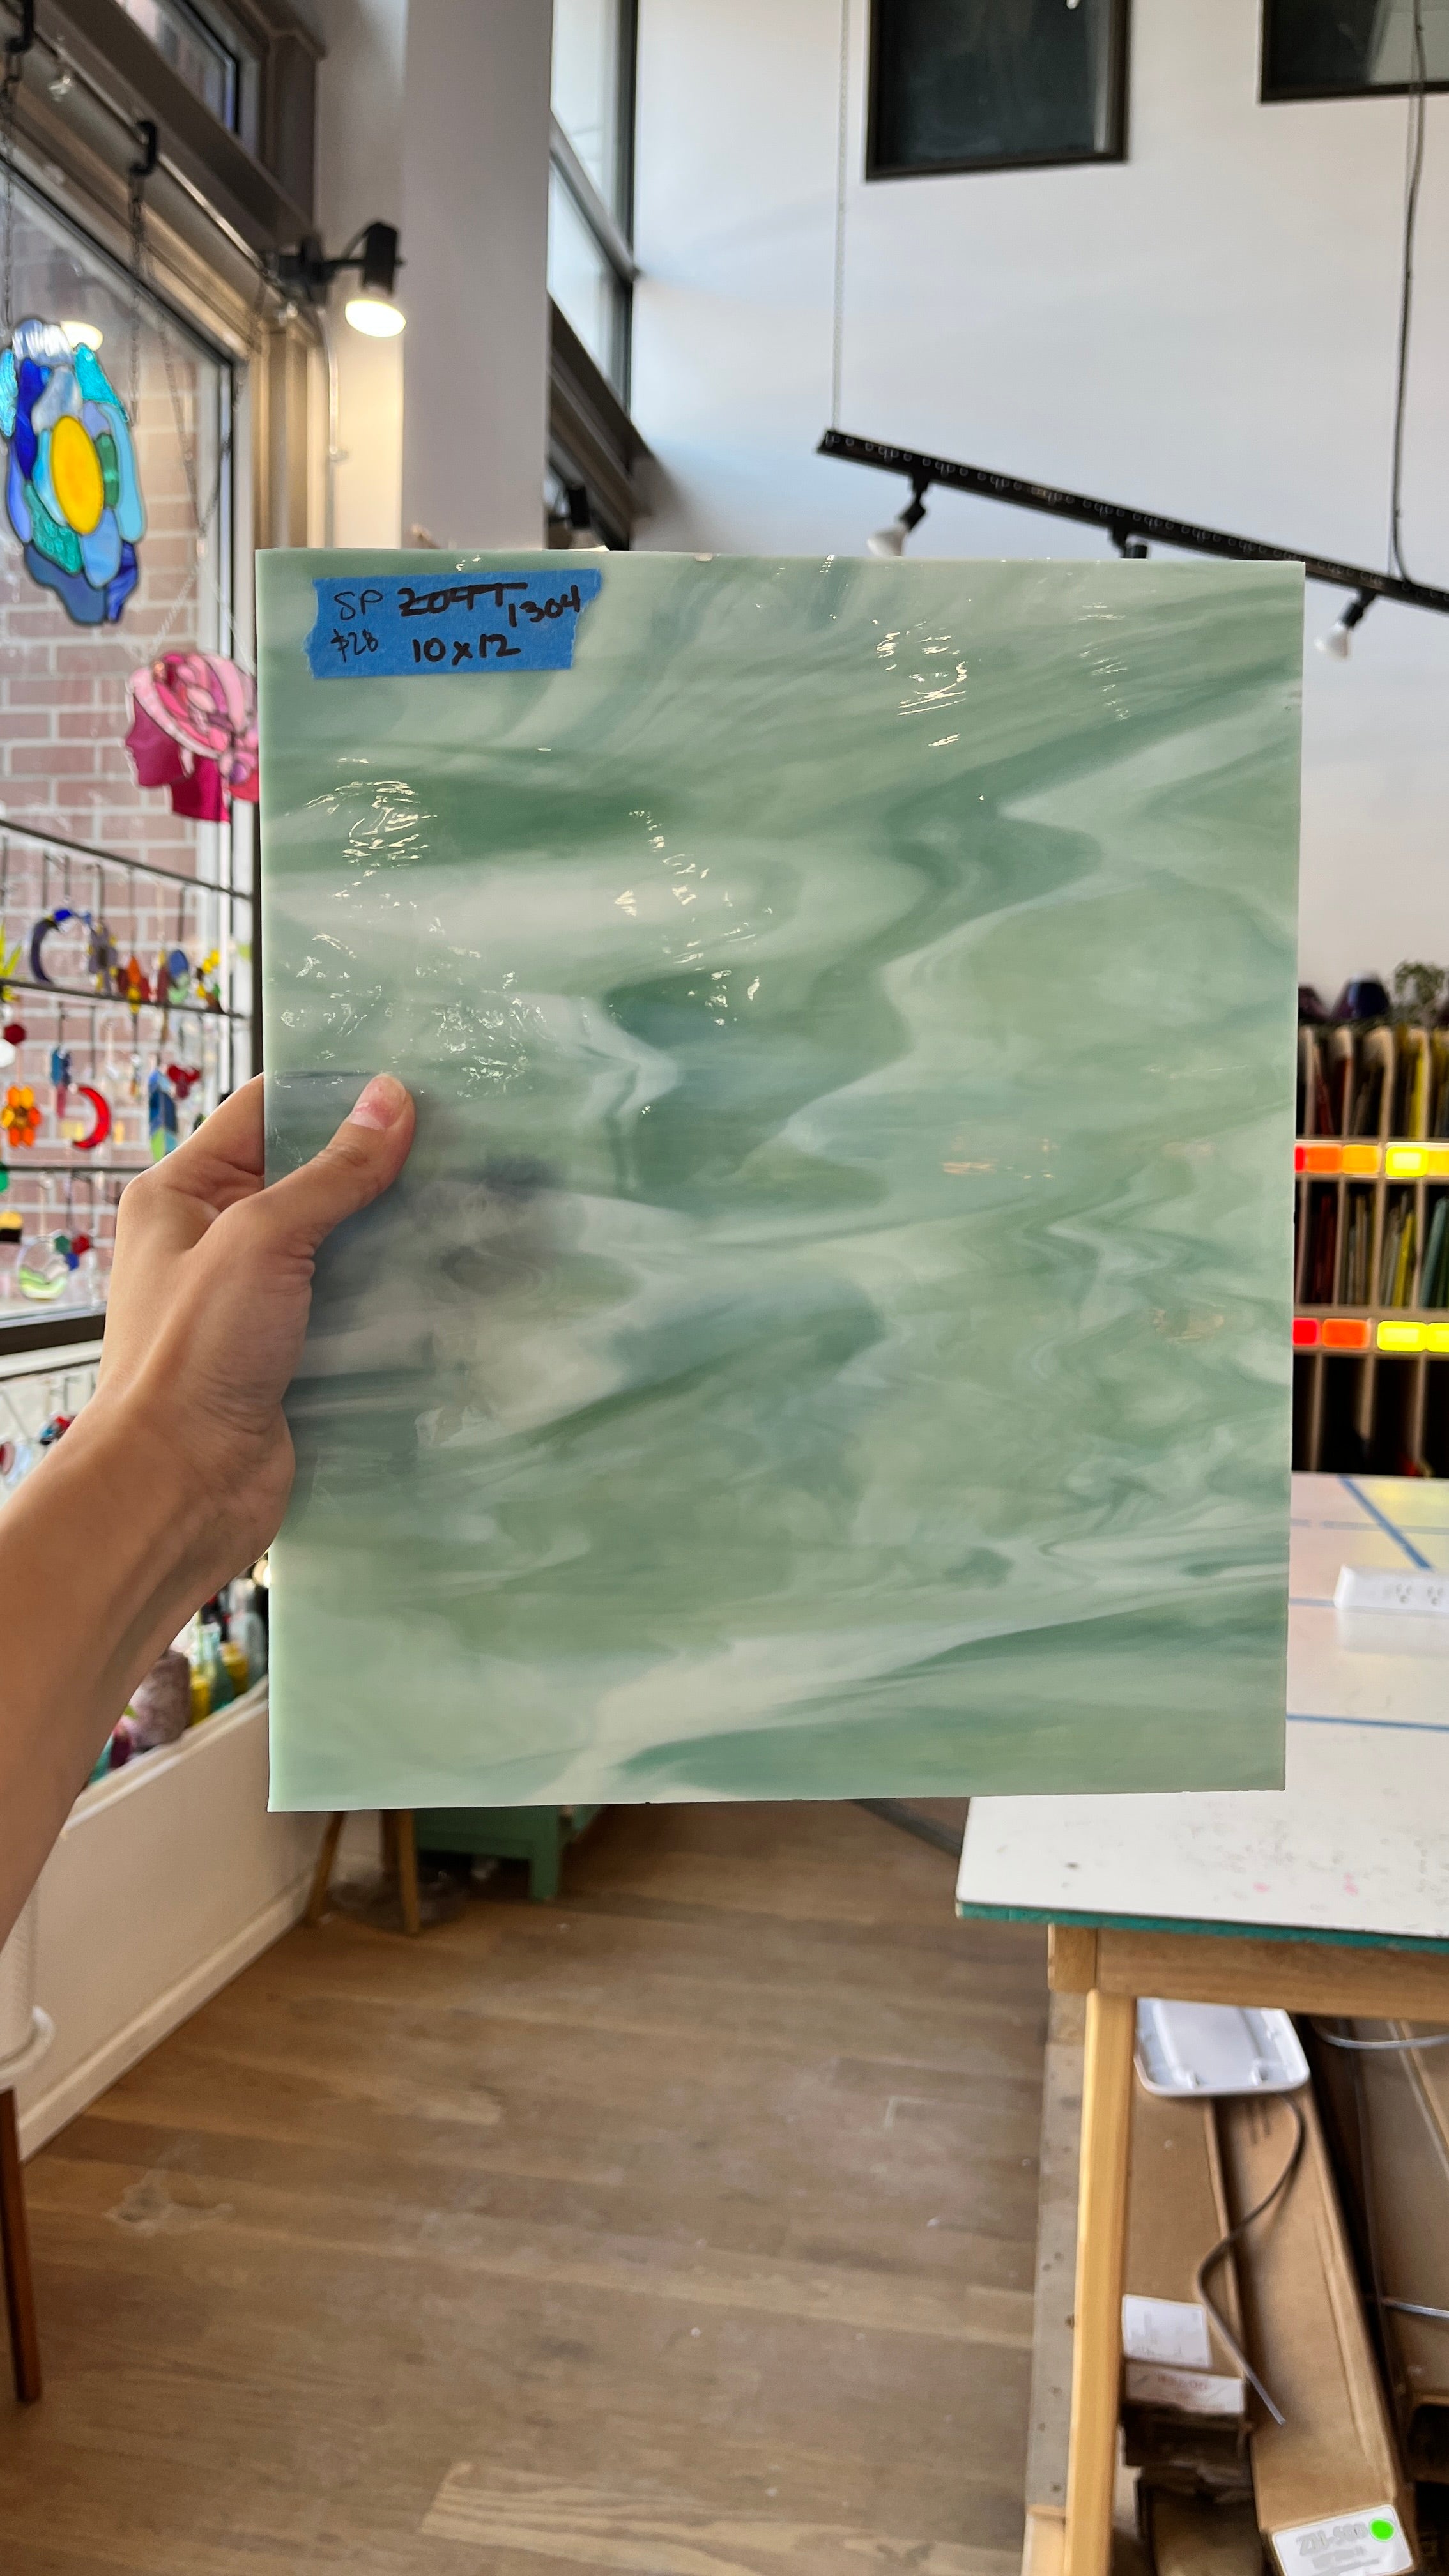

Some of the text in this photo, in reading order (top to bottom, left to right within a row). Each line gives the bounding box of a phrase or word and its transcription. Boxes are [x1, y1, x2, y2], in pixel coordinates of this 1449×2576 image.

[334, 589, 383, 621] SP
[508, 584, 581, 628] 1304
[330, 628, 379, 663] $28
